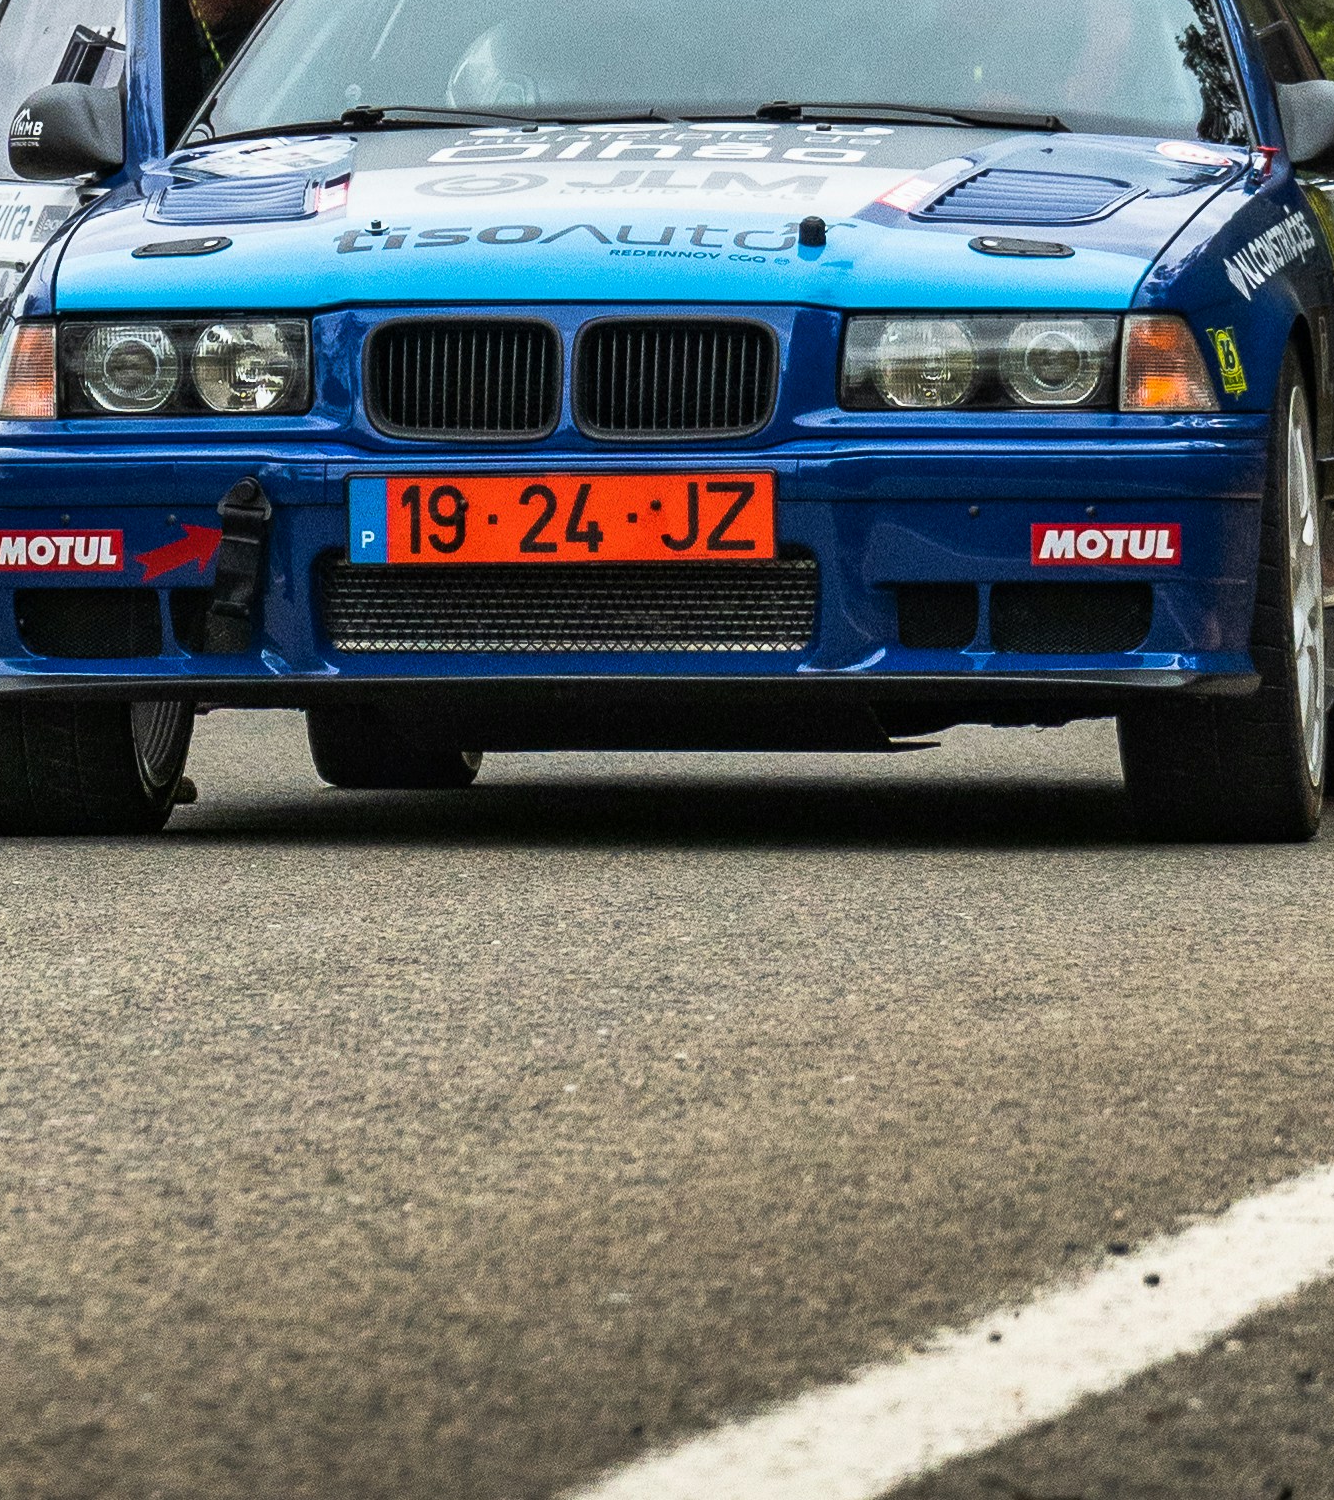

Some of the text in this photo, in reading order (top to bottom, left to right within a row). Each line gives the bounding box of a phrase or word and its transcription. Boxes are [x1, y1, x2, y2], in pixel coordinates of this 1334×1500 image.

[427, 141, 868, 164] Olhão
[565, 170, 829, 195] JLM
[361, 530, 375, 549] P
[1038, 529, 1175, 560] MOTUL
